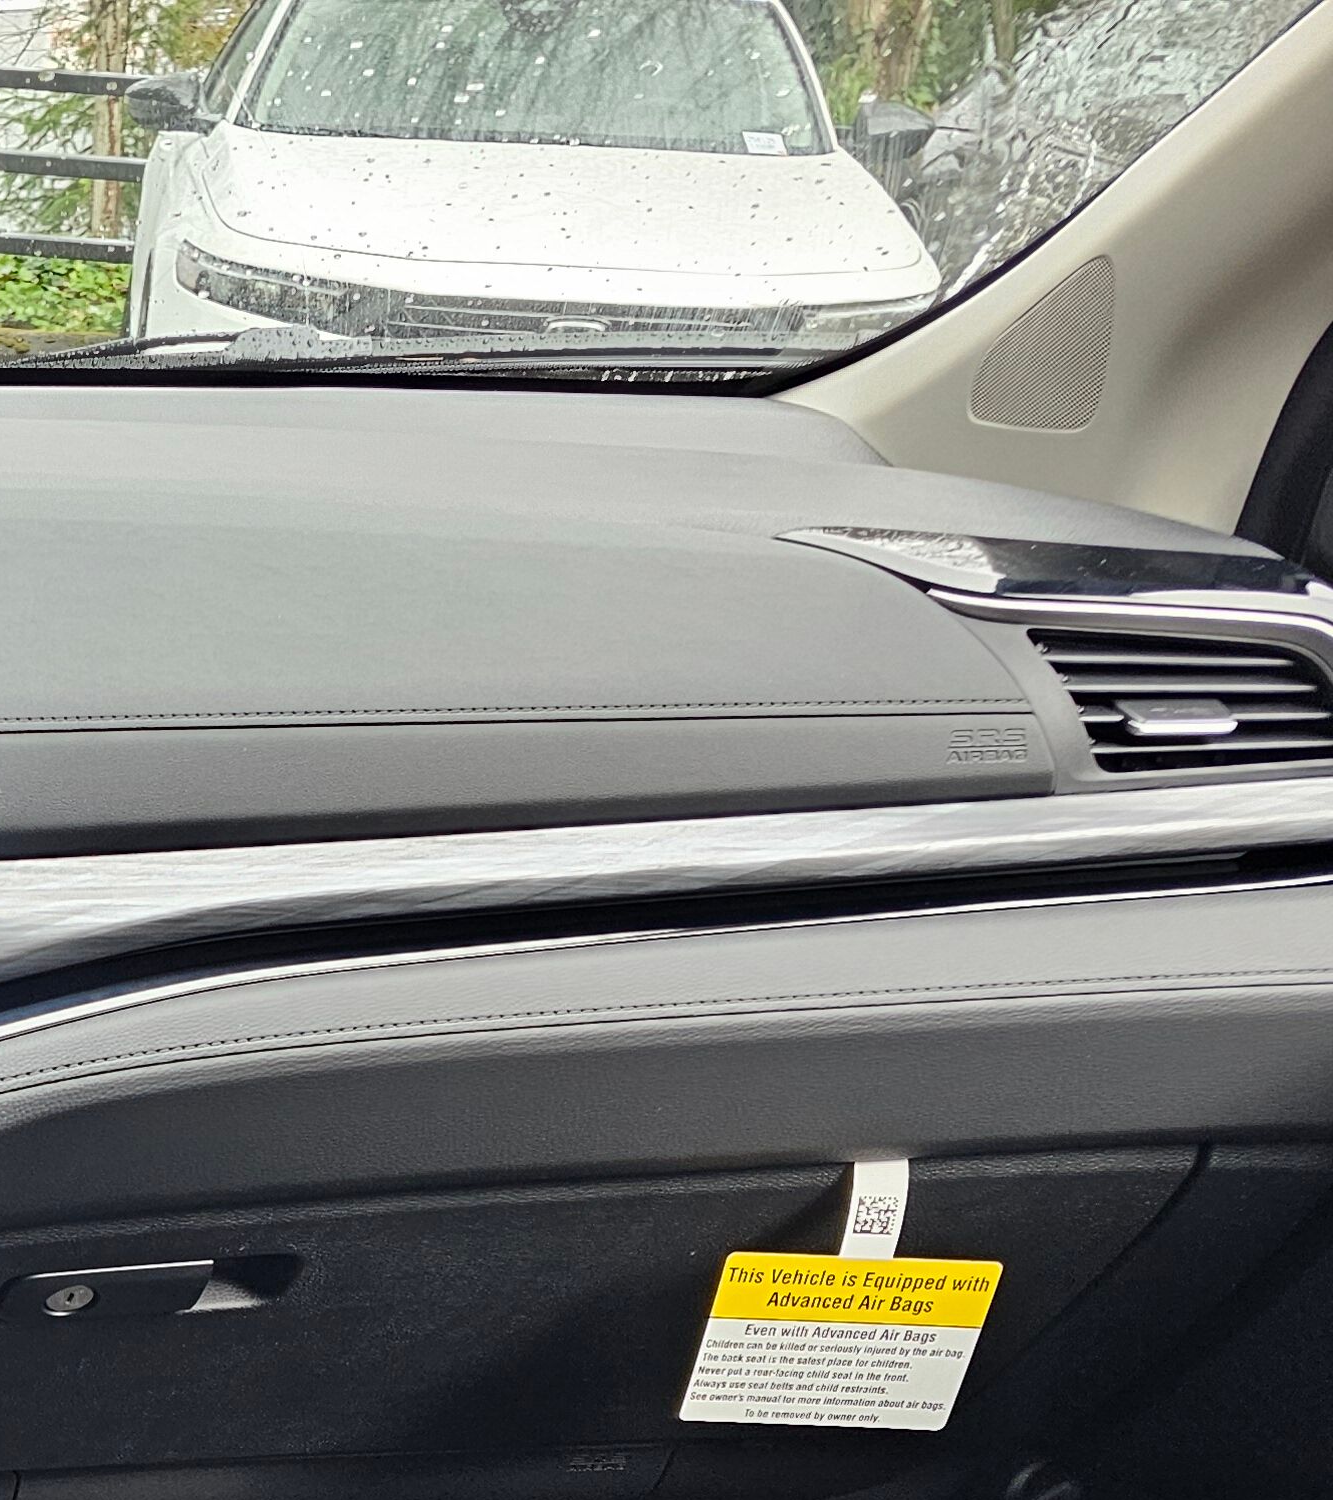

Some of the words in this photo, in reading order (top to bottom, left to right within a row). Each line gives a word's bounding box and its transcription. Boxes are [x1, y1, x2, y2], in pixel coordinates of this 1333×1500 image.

[949, 727, 1027, 744] SRS
[729, 1267, 765, 1284] This
[771, 1268, 836, 1287] Vehicle
[841, 1271, 858, 1287] is
[862, 1272, 948, 1293] Equipped
[952, 1276, 990, 1292] with
[766, 1291, 854, 1310] Advanced
[857, 1294, 885, 1310] Air
[889, 1296, 934, 1316] Bags
[744, 1323, 777, 1336] Even
[781, 1325, 808, 1337] with
[812, 1326, 877, 1340] Advanced
[879, 1329, 901, 1341] Air
[903, 1330, 937, 1345] Bags
[705, 1339, 744, 1350] Children
[746, 1342, 763, 1350] can
[766, 1341, 777, 1351] be
[779, 1341, 806, 1351] killed
[807, 1344, 818, 1352] or
[819, 1344, 862, 1355] seriously
[863, 1346, 897, 1356] injured
[899, 1347, 911, 1357] by
[913, 1347, 927, 1356] the
[929, 1348, 943, 1357] air
[945, 1349, 965, 1360] bag.
[703, 1352, 719, 1362] The
[721, 1353, 743, 1362] back
[746, 1354, 766, 1363] seat
[779, 1355, 794, 1364] the
[796, 1356, 826, 1366] safest
[826, 1358, 853, 1368] place
[855, 1358, 869, 1367] for
[870, 1359, 913, 1370] children.
[698, 1366, 726, 1376] Never
[727, 1367, 743, 1377] put
[753, 1369, 804, 1379] rear-facing
[806, 1370, 831, 1379] child
[832, 1371, 853, 1380] seat
[855, 1371, 864, 1380] in
[866, 1372, 881, 1381] the
[883, 1373, 909, 1383] front.
[693, 1379, 727, 1390] Always
[729, 1381, 746, 1389] use
[748, 1381, 768, 1390] seat
[770, 1382, 794, 1391] belts
[796, 1383, 813, 1391] and
[815, 1384, 839, 1392] child
[840, 1385, 889, 1395] restraints.
[690, 1391, 708, 1401] See
[709, 1393, 744, 1402] owner's
[746, 1394, 781, 1403] manual
[782, 1395, 795, 1404] for
[797, 1397, 822, 1405] more
[823, 1397, 876, 1407] information
[877, 1400, 904, 1408] about
[906, 1401, 920, 1409] air
[921, 1401, 946, 1411] bags.
[744, 1408, 755, 1418] To
[757, 1409, 769, 1418] be
[771, 1410, 812, 1420] removed
[814, 1411, 825, 1421] by
[827, 1413, 856, 1421] owner
[858, 1414, 881, 1424] only.
